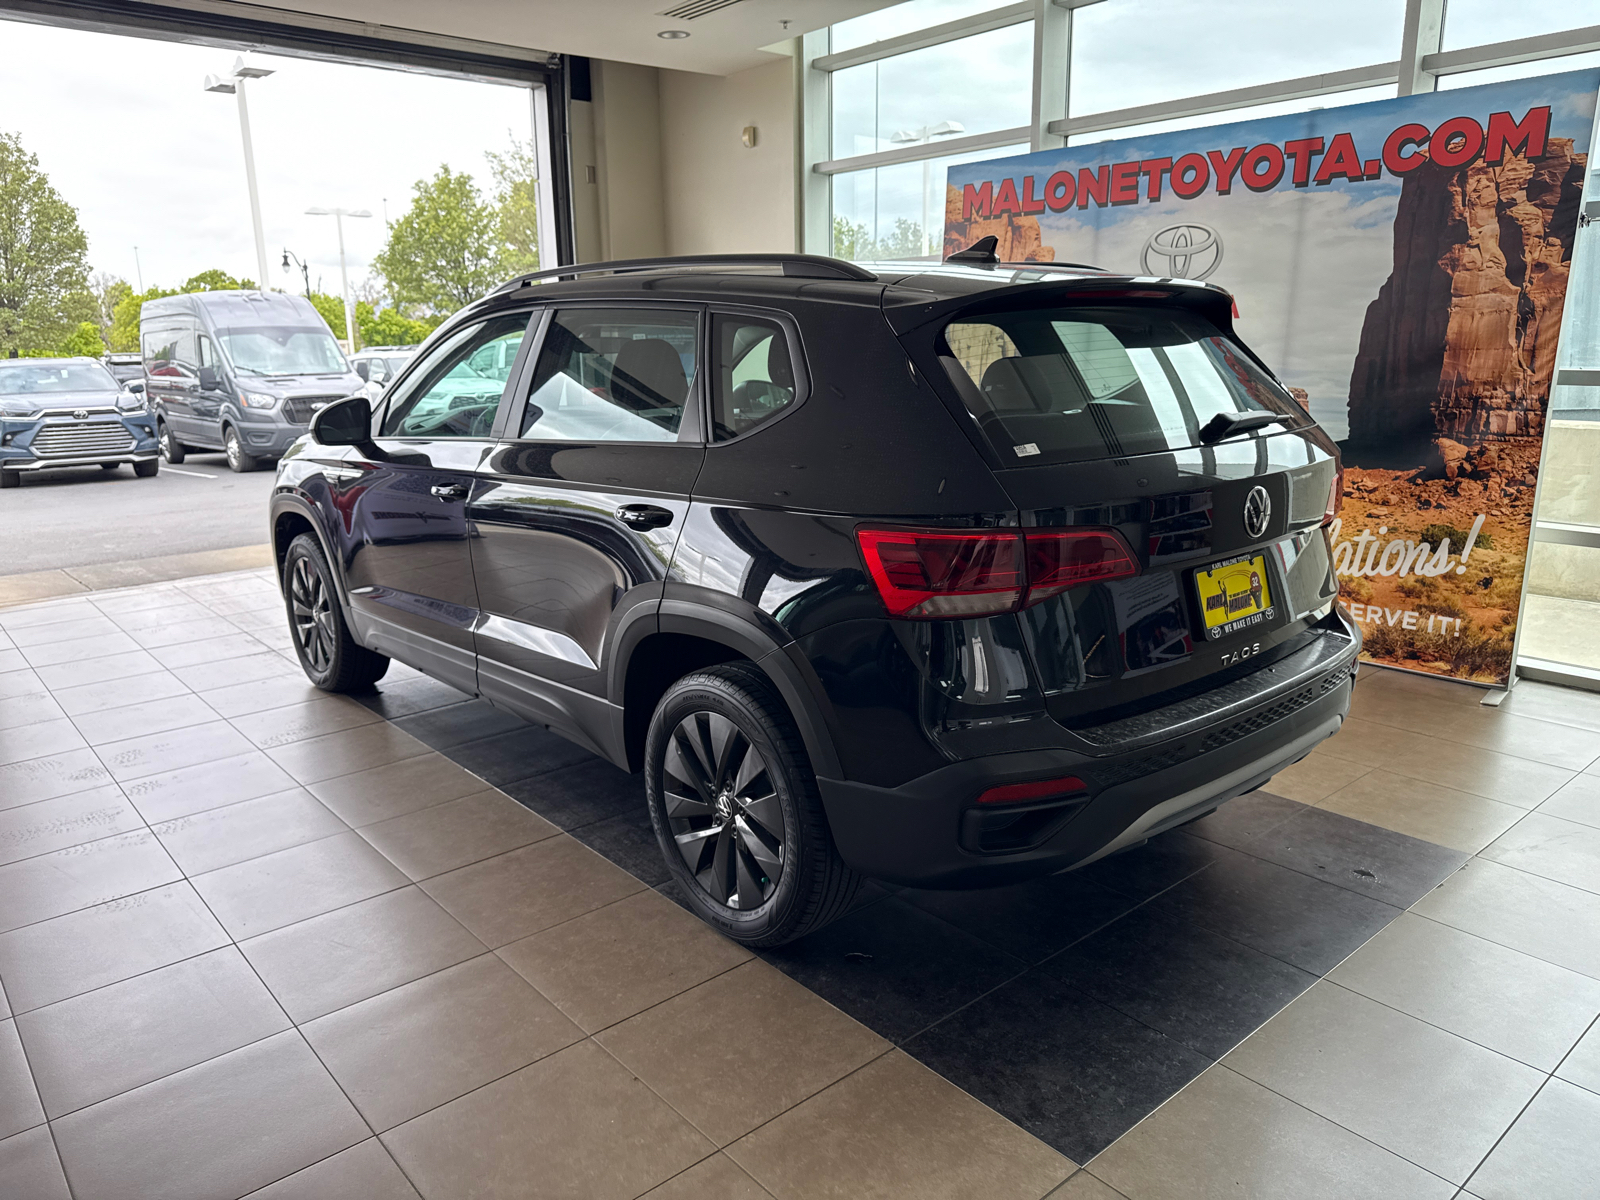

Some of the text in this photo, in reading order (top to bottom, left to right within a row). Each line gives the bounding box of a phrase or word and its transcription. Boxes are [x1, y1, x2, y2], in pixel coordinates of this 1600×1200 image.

[962, 106, 1552, 221] MALONETOYOTA.COM
[1222, 558, 1237, 567] MALONE
[1251, 576, 1259, 587] 32
[1206, 593, 1225, 612] KARL
[1228, 593, 1253, 614] MALONE
[1223, 613, 1263, 634] WE MAKE IT EASY
[1427, 614, 1462, 637] IT!
[1221, 643, 1260, 666] TAOS
